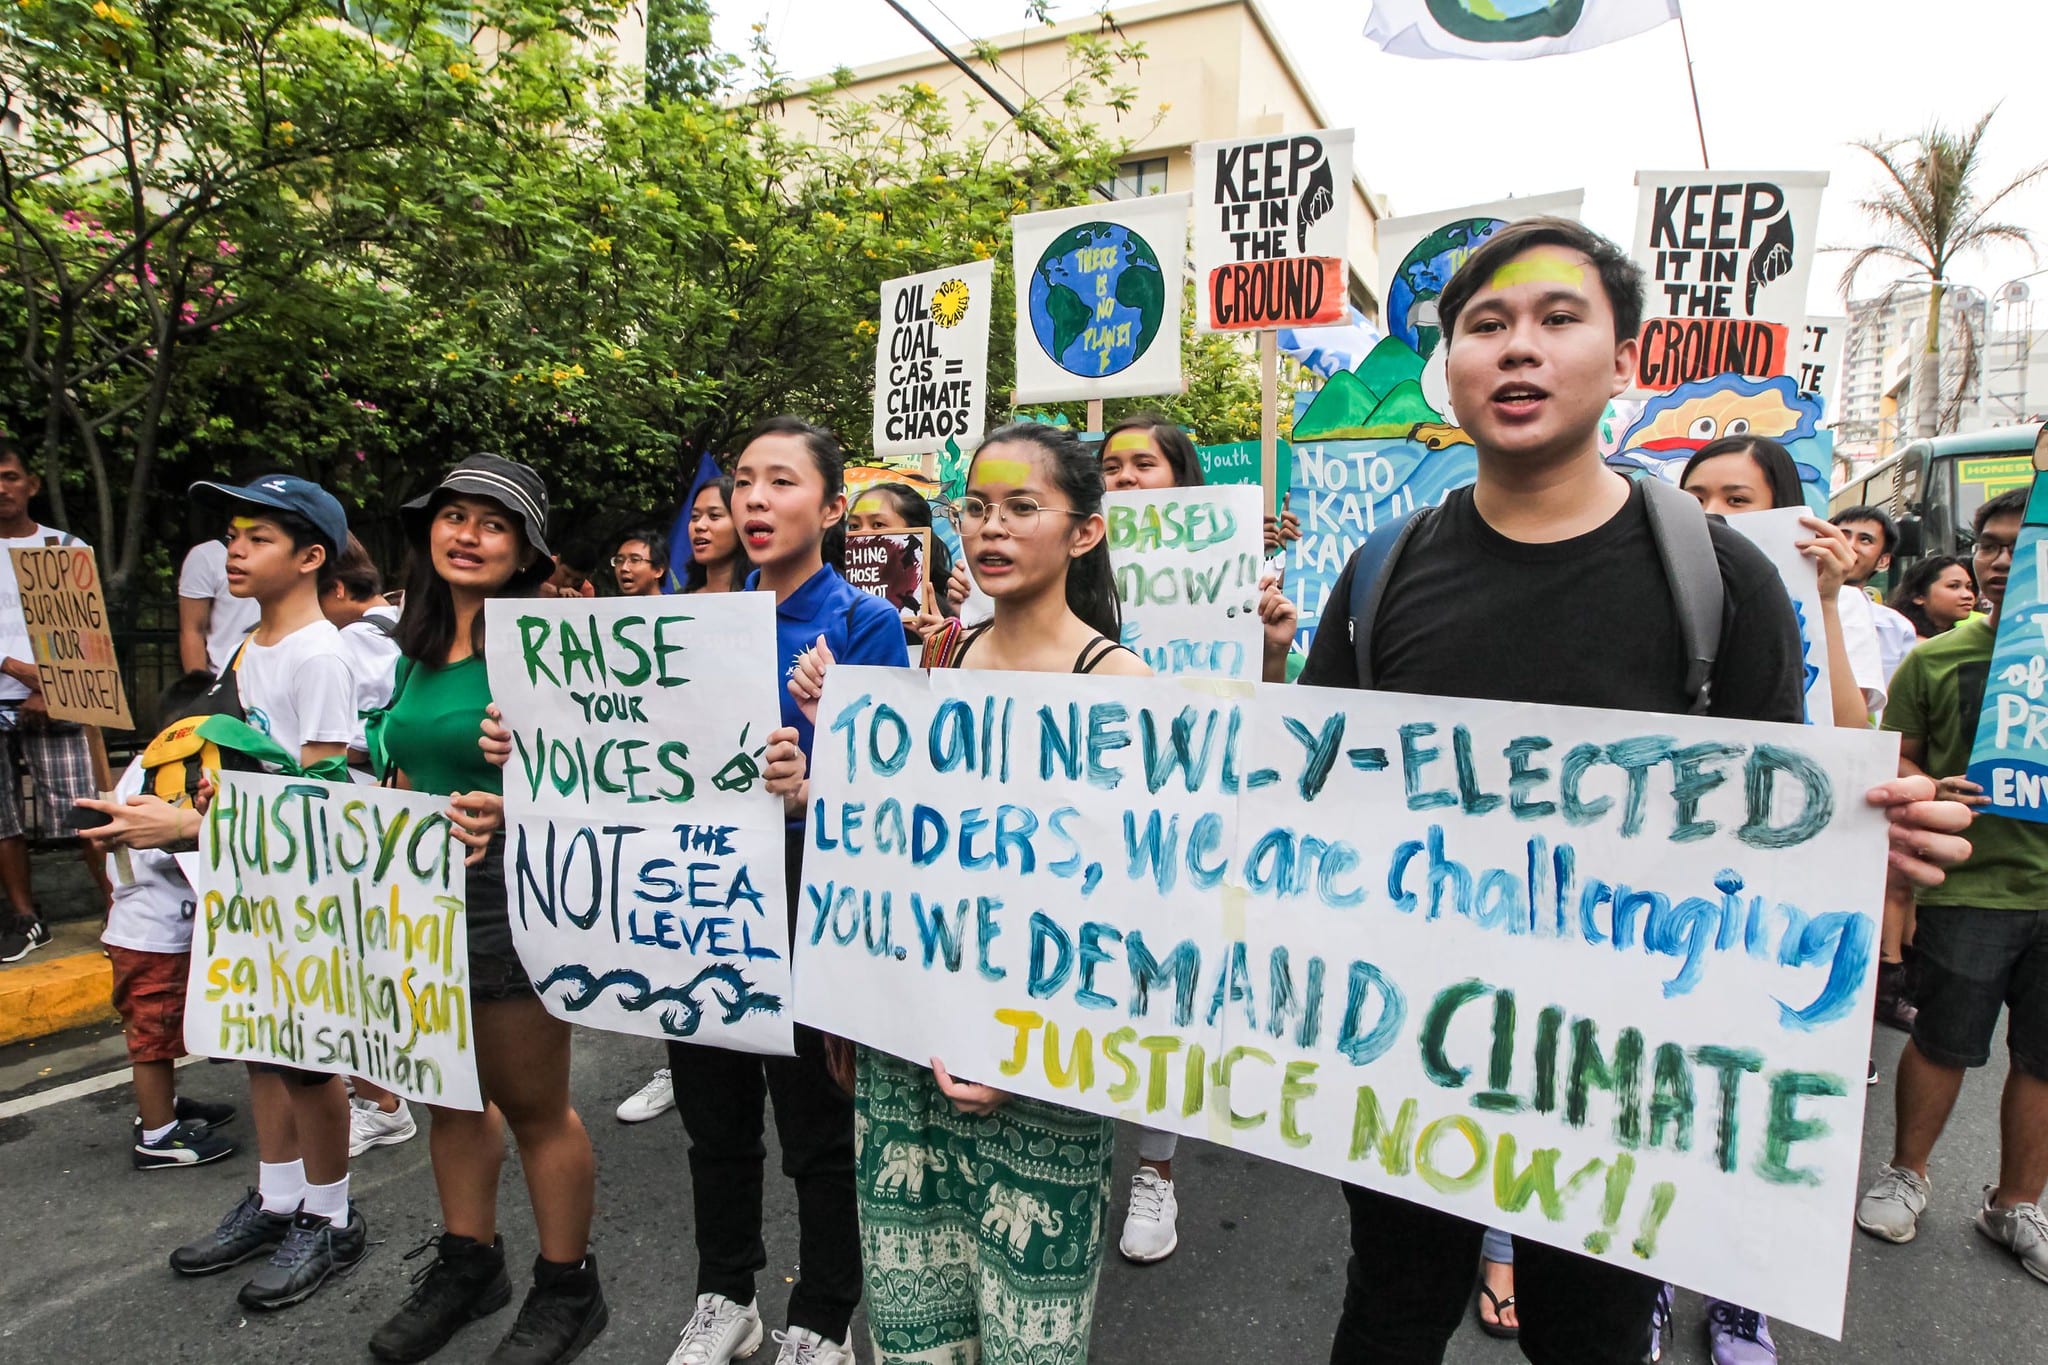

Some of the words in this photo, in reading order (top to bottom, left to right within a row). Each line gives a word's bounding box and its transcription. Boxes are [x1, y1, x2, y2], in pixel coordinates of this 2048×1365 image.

[1215, 136, 1323, 204] KEEP
[1221, 203, 1250, 232] IT
[1259, 199, 1289, 229] IN
[1649, 182, 1785, 249] KEEP
[1230, 230, 1287, 260] THE
[1655, 251, 1691, 281] IT
[1700, 251, 1738, 282] IN
[1096, 273, 1108, 297] IS
[1096, 297, 1116, 322] NO
[1215, 259, 1324, 324] GROUND
[1664, 284, 1732, 317] THE
[1084, 321, 1132, 351] PLANET
[1639, 319, 1773, 386] GROUND
[887, 380, 972, 415] CLIMATE
[885, 409, 969, 441] CHAOS
[1106, 502, 1238, 554] BASED
[20, 549, 70, 591] STOP
[21, 592, 100, 629] BURNING
[53, 630, 85, 660] OUR
[516, 614, 695, 689] RAISE
[570, 690, 649, 725] YOUR
[830, 693, 912, 784] TO
[513, 727, 695, 804] VOICES
[673, 823, 742, 857] THE
[516, 820, 647, 944] NOT
[634, 858, 766, 918] SEA
[1243, 827, 1370, 907] are
[204, 889, 285, 957] para
[294, 894, 347, 945] sa
[627, 908, 781, 963] LEVEL
[205, 956, 258, 1002] sa
[219, 1003, 306, 1062] Hindi
[315, 1026, 360, 1072] sa
[910, 891, 1007, 982] WE
[1028, 907, 1408, 1067] DEMAND
[1416, 976, 1850, 1188] CLIMATE
[993, 1009, 1320, 1149] JUSTICE
